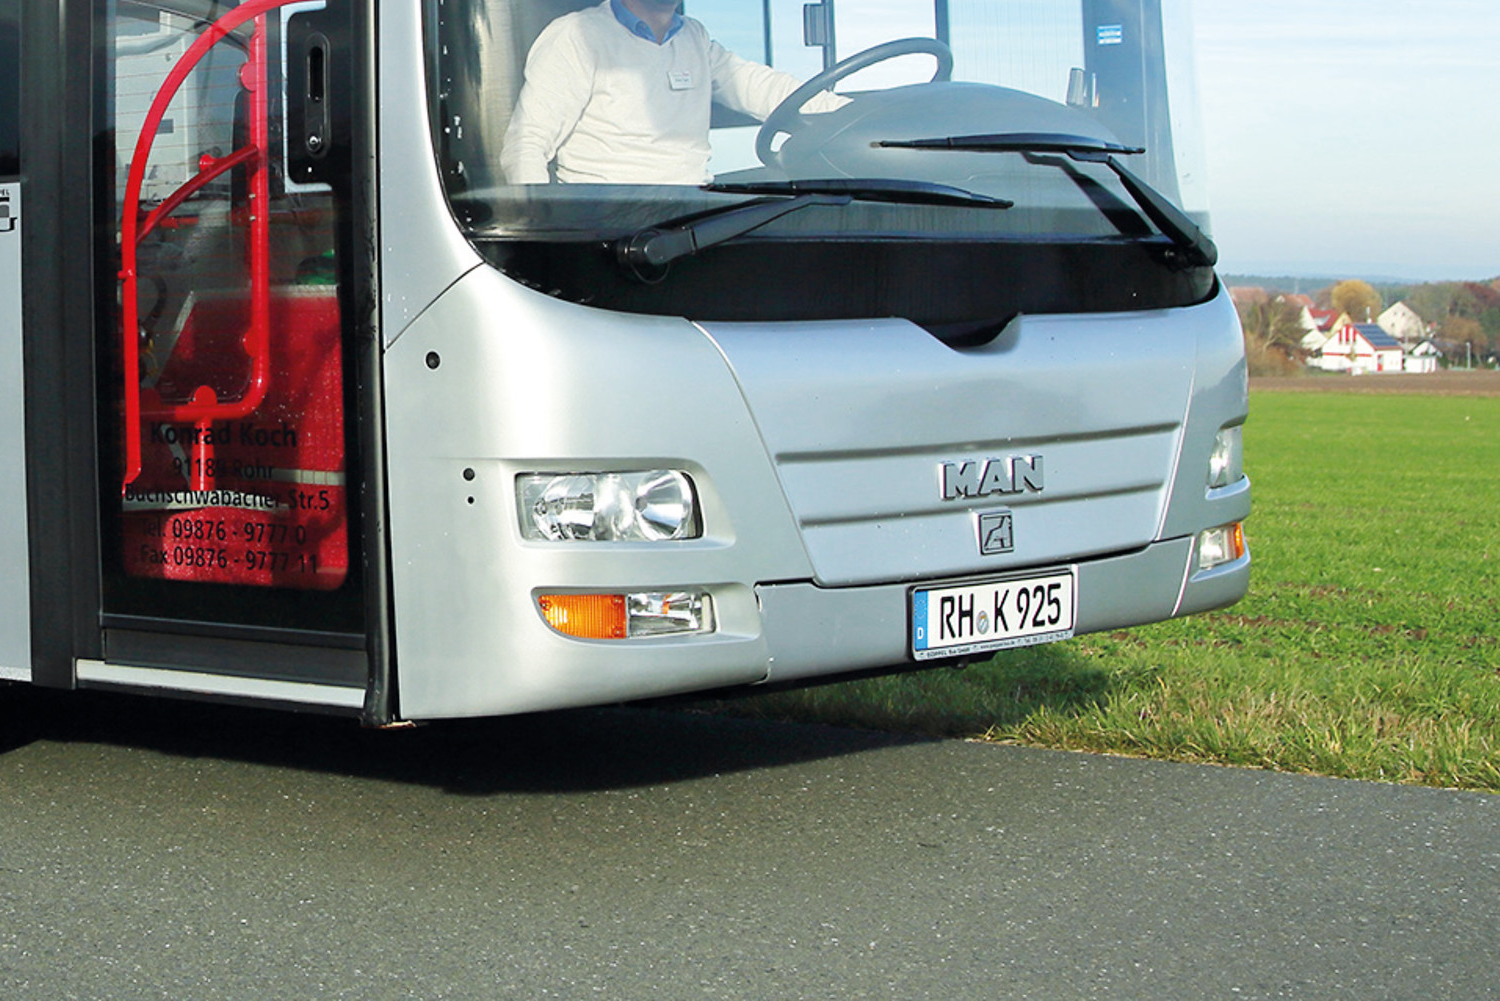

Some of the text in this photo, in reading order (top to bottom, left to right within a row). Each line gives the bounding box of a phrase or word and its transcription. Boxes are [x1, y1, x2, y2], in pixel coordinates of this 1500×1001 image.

[151, 422, 298, 448] Konrad Koch
[938, 454, 1044, 501] MAN
[289, 488, 330, 511] Str.5
[172, 518, 227, 541] 09876
[244, 523, 288, 545] 9777
[296, 525, 307, 545] 0
[141, 545, 168, 564] Fax
[173, 546, 228, 569] 09876
[246, 550, 289, 572] 9777
[298, 554, 318, 574] 11
[940, 582, 1062, 640] RH K 925
[917, 627, 924, 640] D
